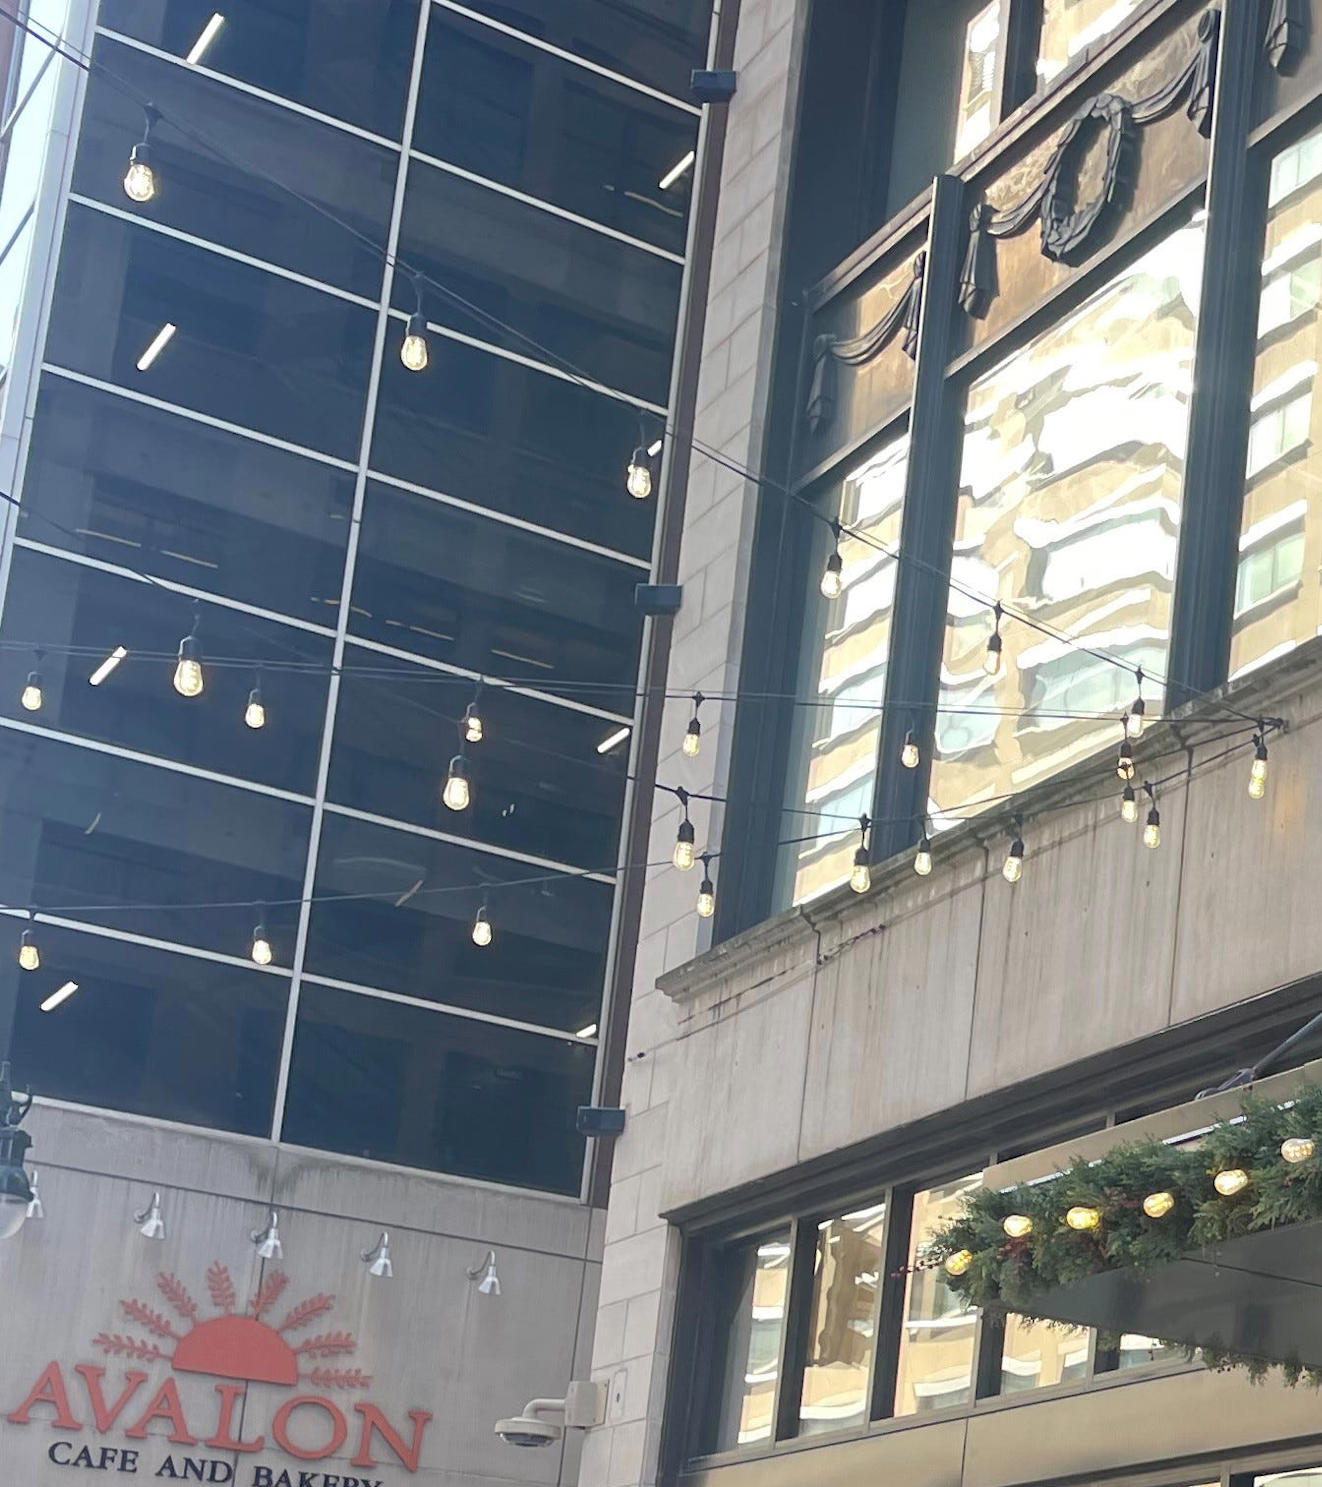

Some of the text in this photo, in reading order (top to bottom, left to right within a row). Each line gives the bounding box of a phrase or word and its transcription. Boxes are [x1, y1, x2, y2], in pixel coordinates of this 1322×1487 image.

[7, 1361, 432, 1473] AVALON
[48, 1441, 140, 1474] CAFE
[155, 1455, 234, 1483] AND
